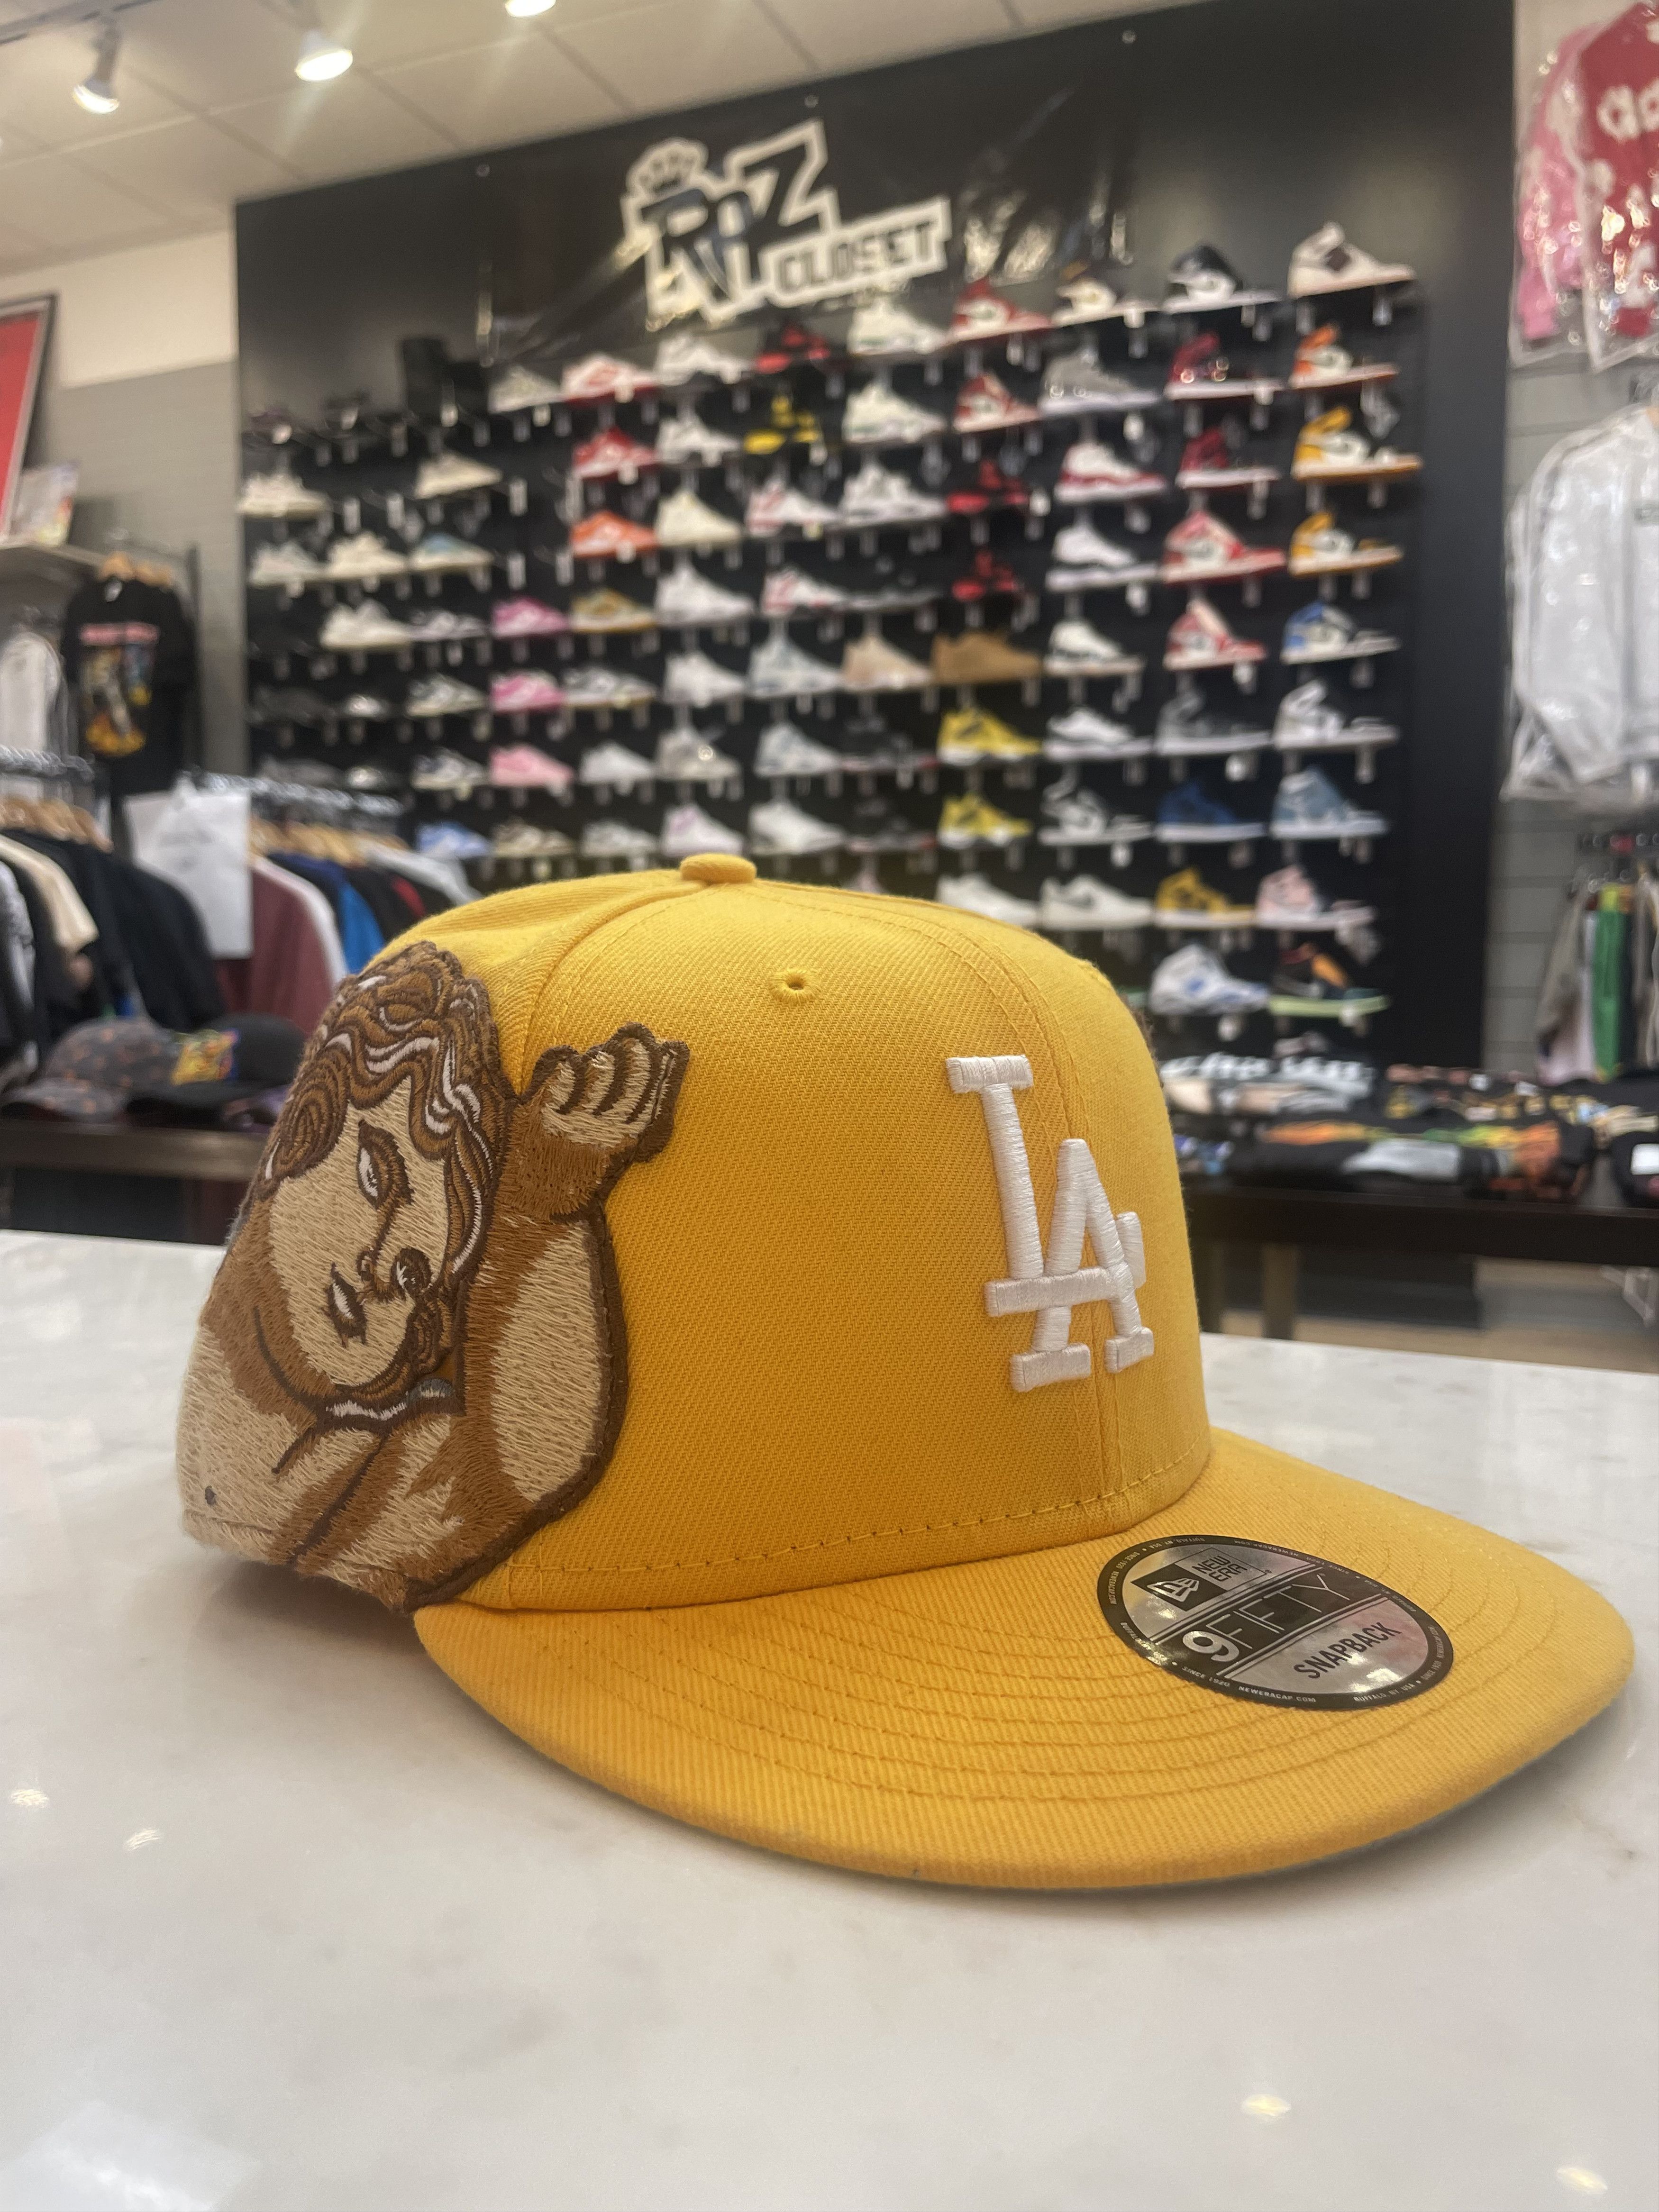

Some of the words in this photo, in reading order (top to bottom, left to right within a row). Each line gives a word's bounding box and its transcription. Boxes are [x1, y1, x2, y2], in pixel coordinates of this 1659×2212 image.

[774, 213, 939, 290] CLOSET
[945, 1054, 1155, 1392] LA
[1192, 1555, 1231, 1574] NEW
[1208, 1564, 1248, 1582] ERA
[1182, 1574, 1350, 1662] 9FIFTY
[1293, 1622, 1403, 1679] SNAPBACK
[1182, 1666, 1206, 1679] SINCE
[1209, 1677, 1231, 1687] 1920
[1239, 1685, 1316, 1703] NEWERACAP.COM
[1401, 1683, 1416, 1691] USA
